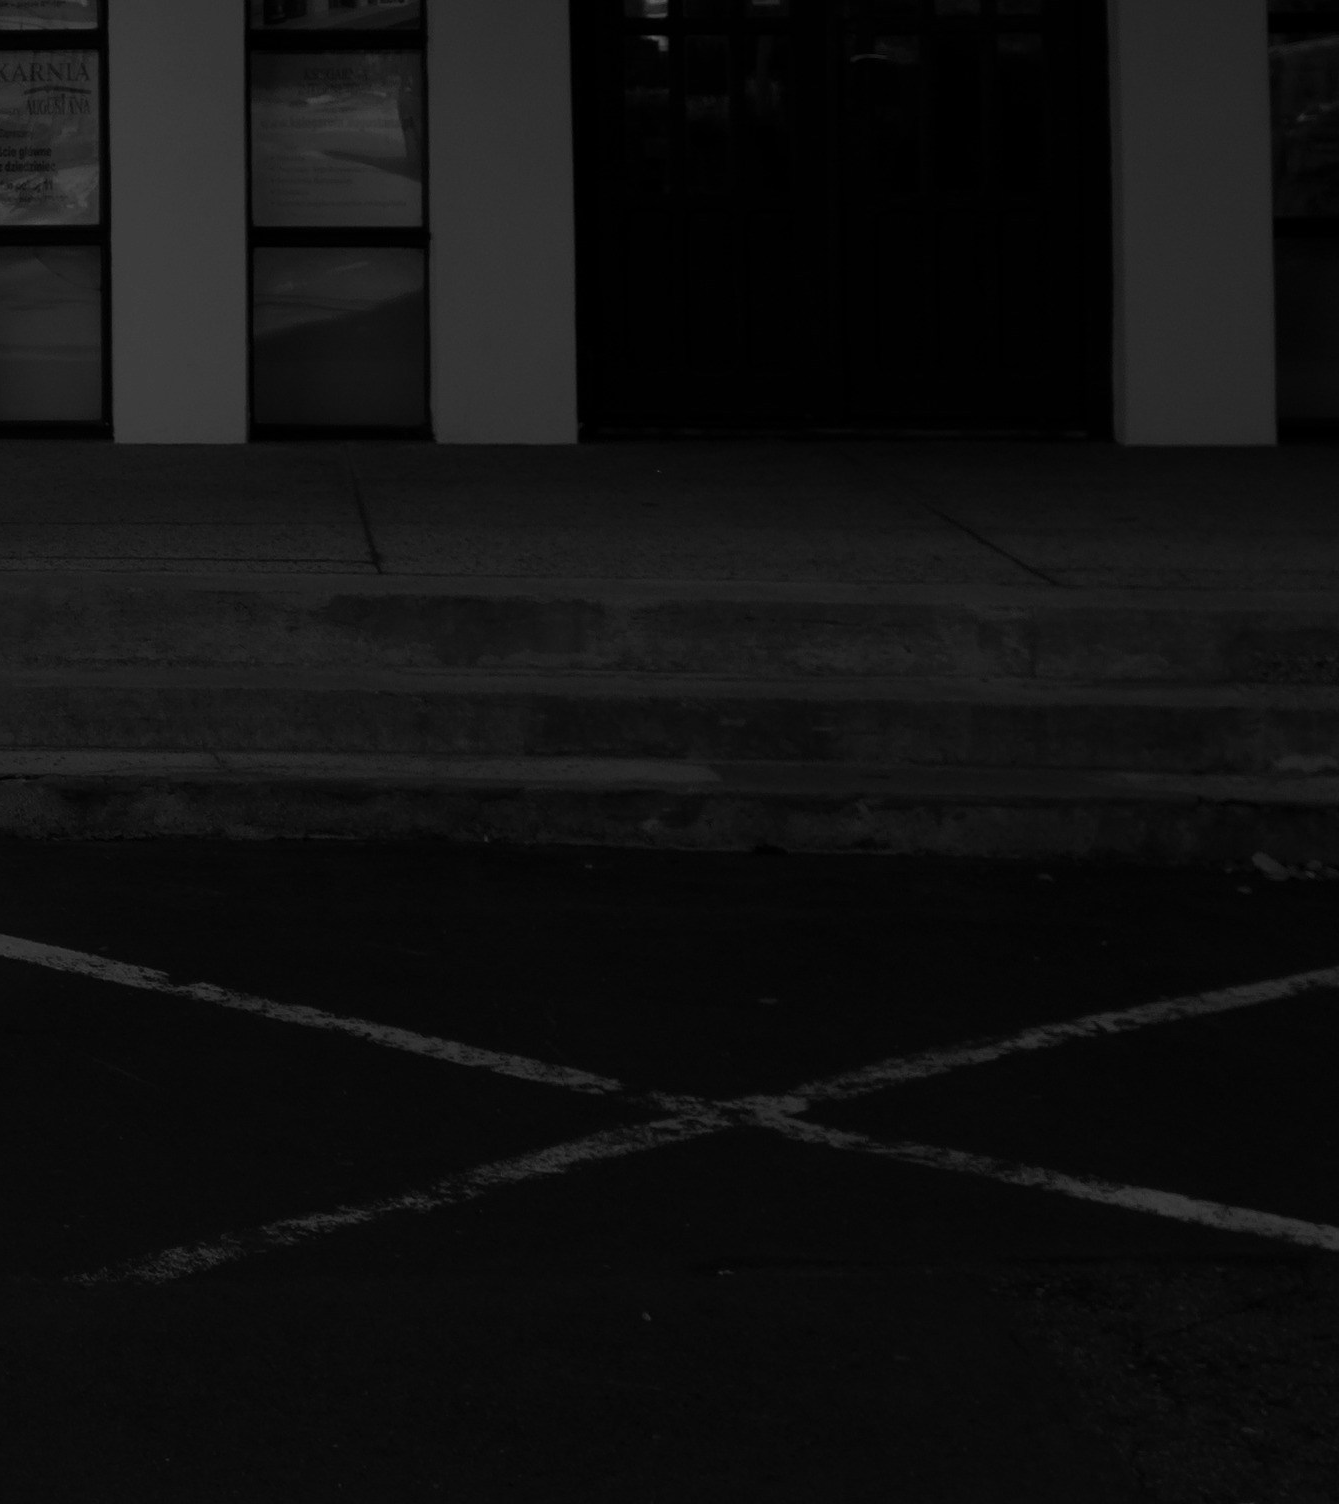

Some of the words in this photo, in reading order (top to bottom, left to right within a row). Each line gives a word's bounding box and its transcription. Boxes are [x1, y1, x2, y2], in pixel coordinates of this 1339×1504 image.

[27, 94, 92, 116] AUGUSTANA
[19, 146, 52, 160] główne
[4, 161, 57, 174] dziedziniec
